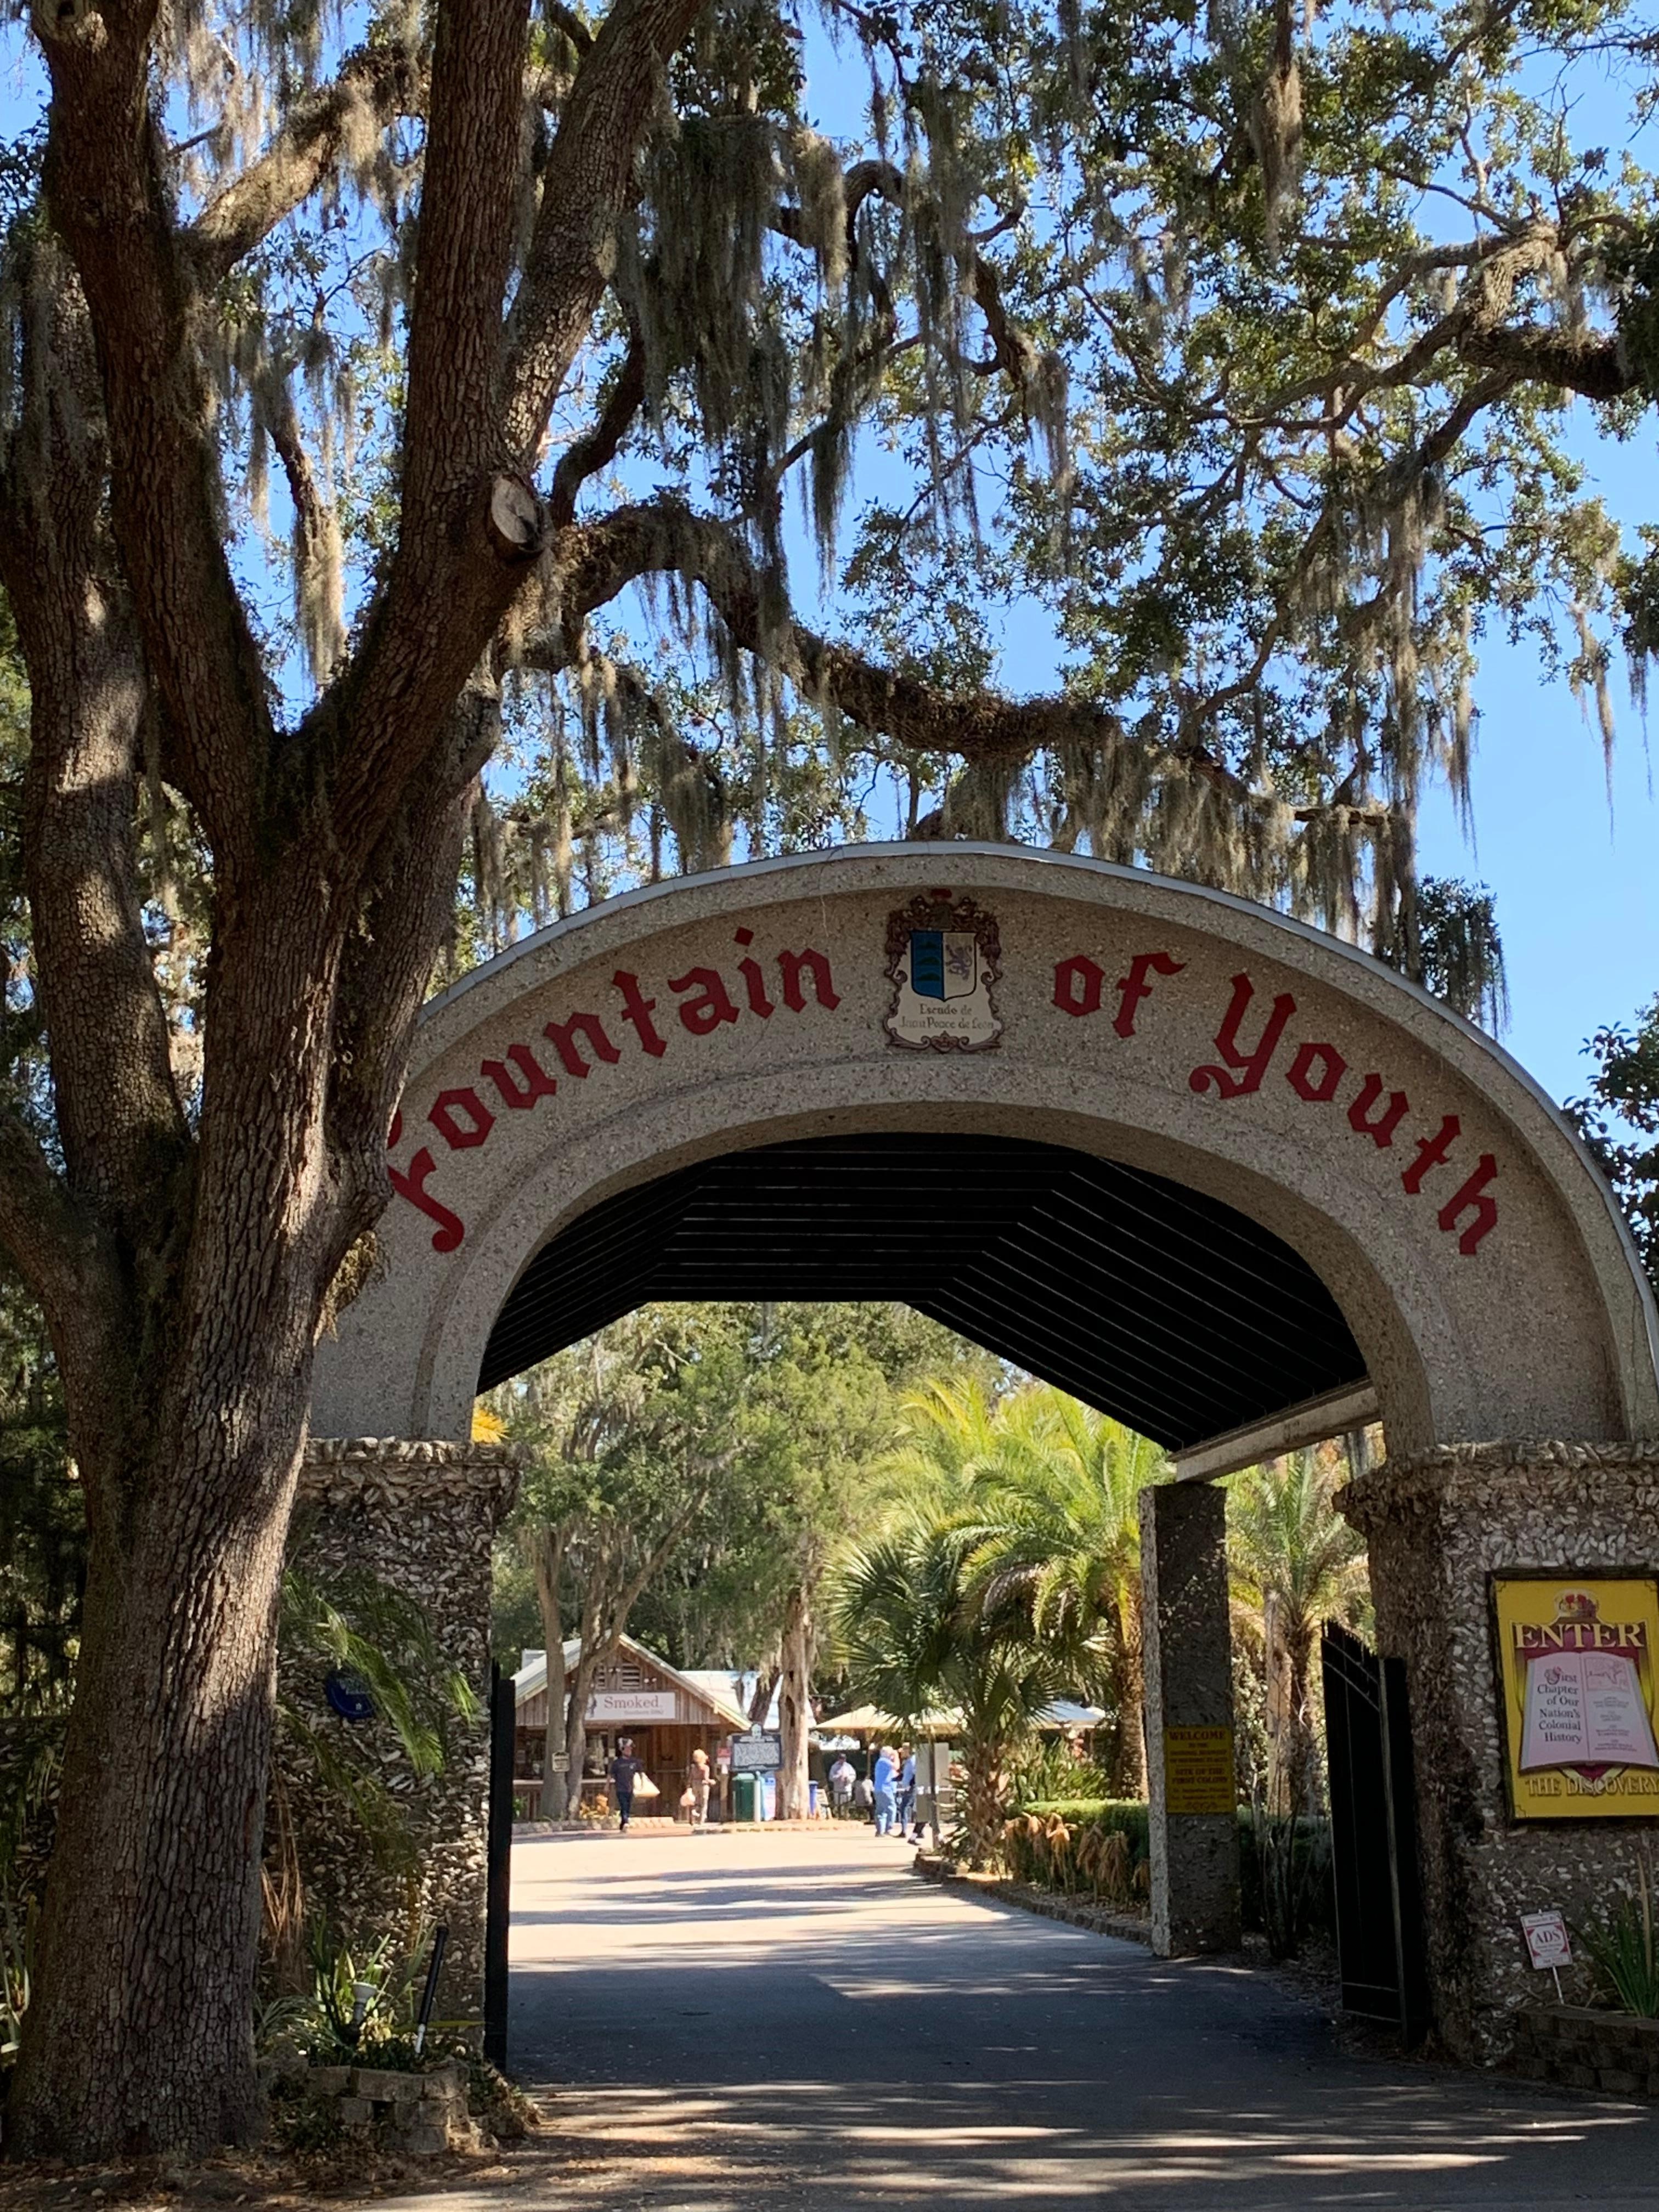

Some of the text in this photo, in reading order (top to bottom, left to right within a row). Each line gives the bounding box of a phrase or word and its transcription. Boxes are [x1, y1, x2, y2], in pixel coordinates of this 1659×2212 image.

[919, 1003, 973, 1015] Escudo de
[899, 1016, 926, 1028] Juan
[927, 1017, 956, 1029] Ponce
[958, 1017, 970, 1029] de
[1053, 952, 1186, 1038] of
[1189, 972, 1498, 1254] Youth
[1515, 1622, 1645, 1648] ENTER
[1544, 1666, 1577, 1685] First
[1537, 1684, 1578, 1695] Chapter
[604, 1695, 658, 1709] Smoked
[1546, 1695, 1557, 1705] of
[1559, 1695, 1579, 1706] Our
[1539, 1708, 1581, 1718] Nation's
[1538, 1719, 1581, 1730] Colonial
[1169, 1730, 1225, 1740] WELCOME
[1544, 1732, 1582, 1745] History
[1525, 1776, 1659, 1796] THE DISCOVERY
[1536, 1929, 1561, 1943] ADS
